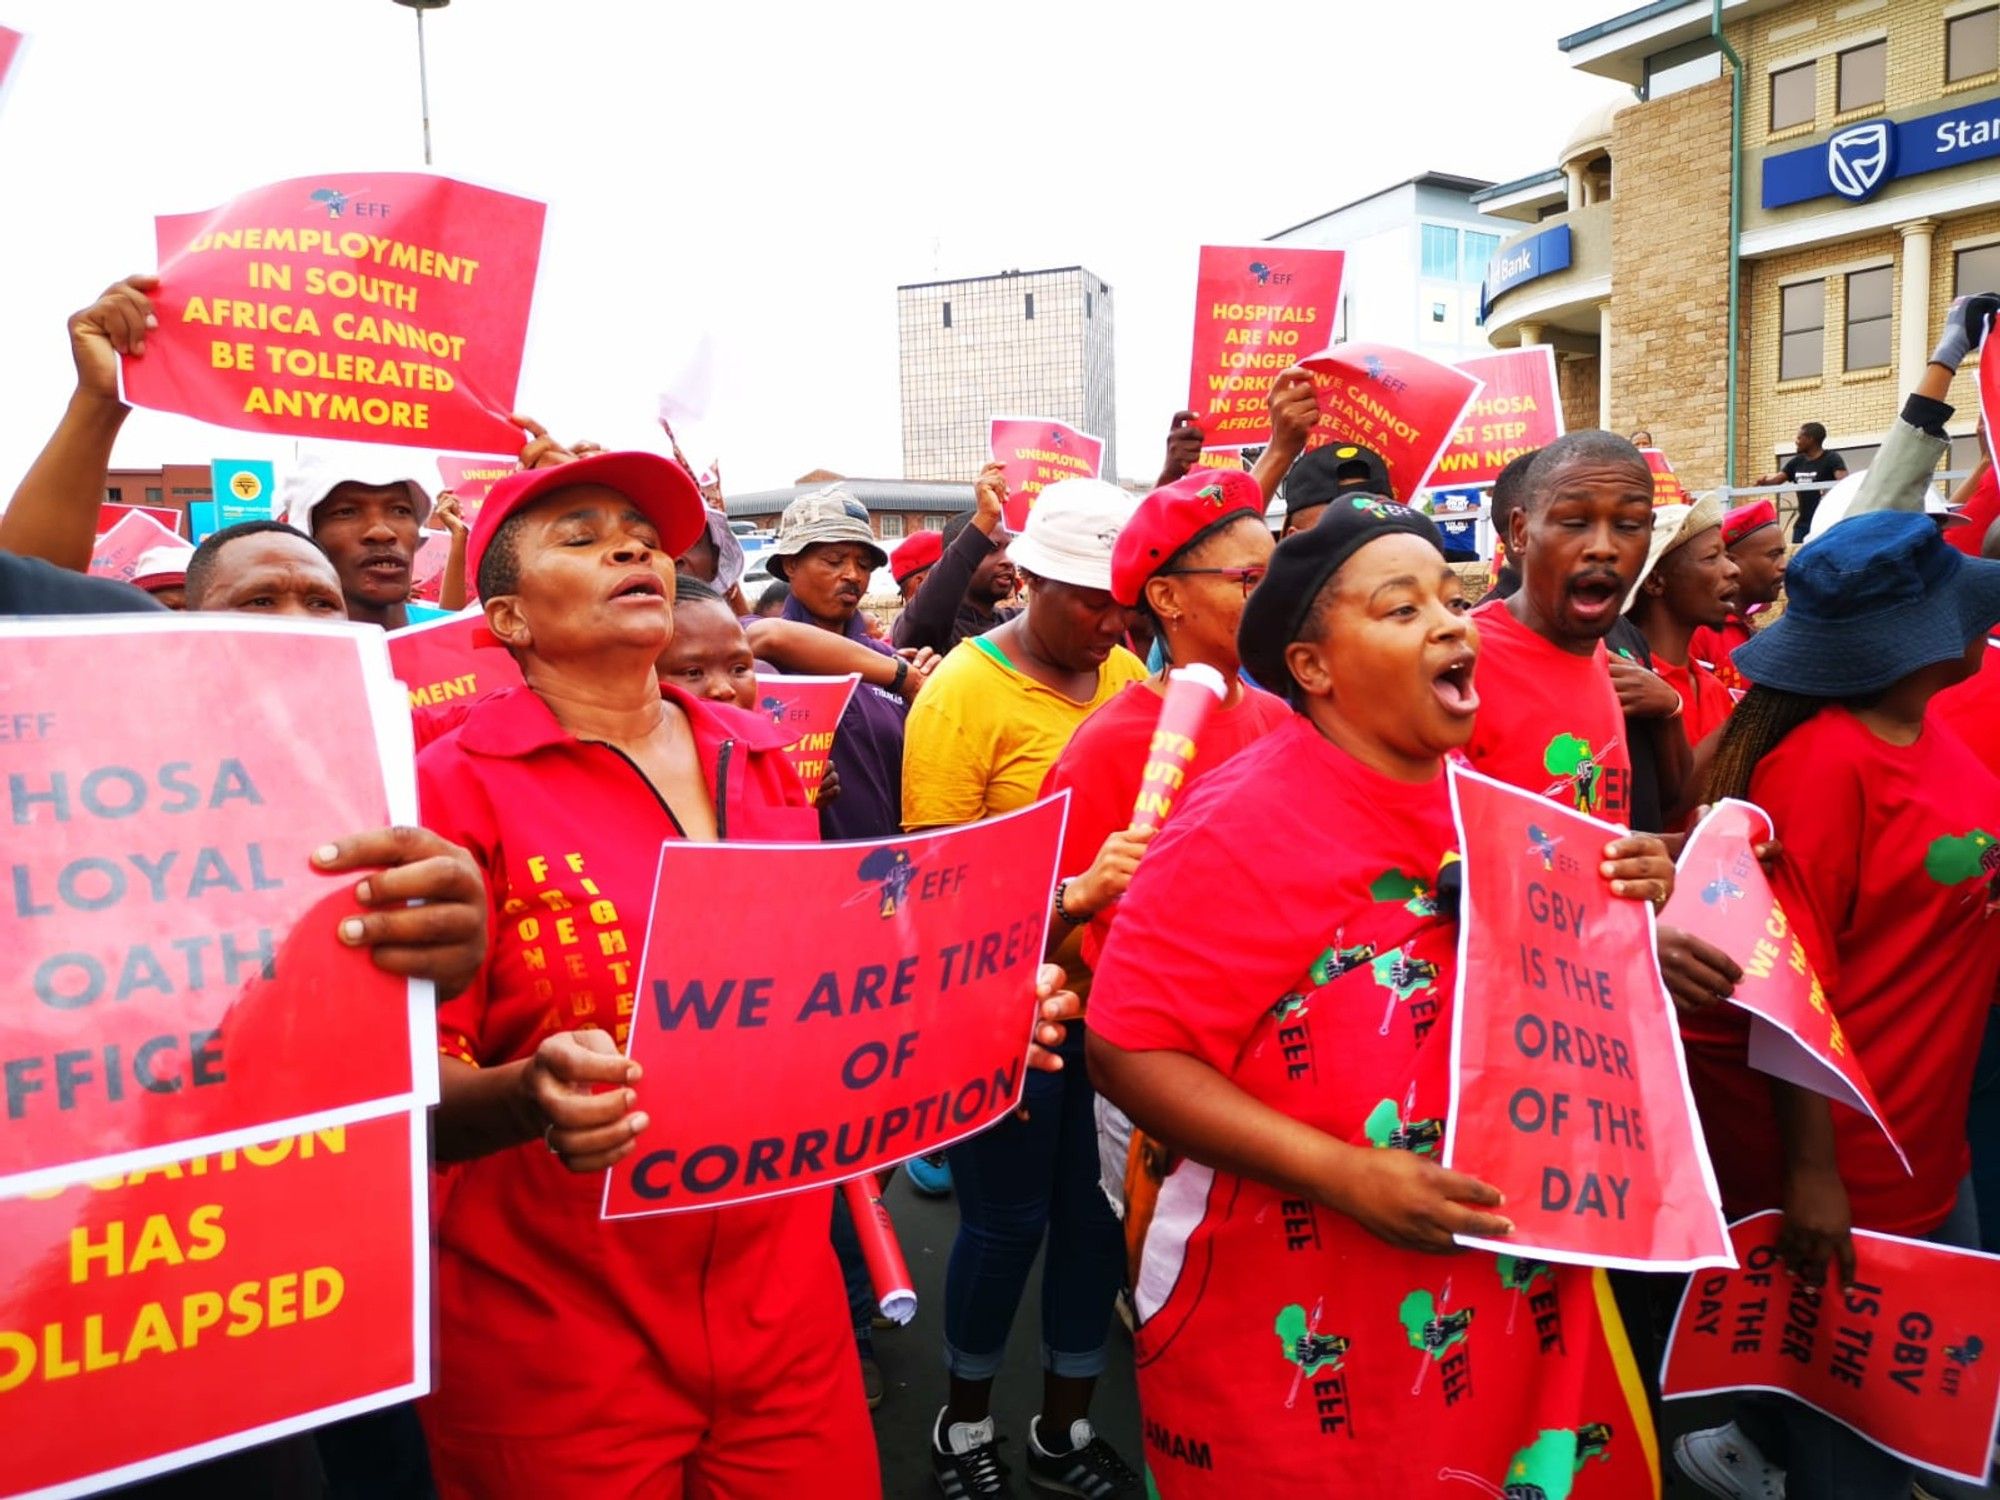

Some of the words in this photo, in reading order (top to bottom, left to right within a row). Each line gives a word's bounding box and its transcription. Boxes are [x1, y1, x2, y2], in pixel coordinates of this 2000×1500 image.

[355, 201, 391, 218] EFF
[189, 227, 479, 286] UNEMPLOYMENT
[1272, 273, 1293, 285] EFF
[1502, 248, 1532, 281] Bank
[248, 262, 290, 290] IN
[305, 267, 417, 313] SOUTH
[1212, 303, 1316, 323] HOSPITALS
[183, 297, 320, 337] AFRICA
[332, 313, 465, 362] CANNOT
[1224, 328, 1262, 345] ARE
[1267, 330, 1299, 346] NO
[211, 341, 254, 371] BE
[267, 346, 455, 394] TOLERATED
[1208, 375, 1276, 391] WORKI
[1220, 352, 1297, 369] LONGER
[1381, 375, 1408, 393] EFF
[244, 388, 429, 430] ANYMORE
[1209, 398, 1230, 414] IN
[1311, 371, 1344, 390] WE
[1347, 385, 1421, 444] CANNOT
[1329, 395, 1376, 432] HAVE
[1376, 432, 1389, 446] A
[1481, 421, 1527, 442] STEP
[1485, 446, 1541, 468] NO
[790, 709, 811, 722] EFF
[8, 757, 265, 826] HOSA
[12, 842, 284, 918] LOYAL
[918, 863, 970, 903] EFF
[1527, 881, 1586, 939] GBV
[1745, 938, 1781, 980] WE
[1765, 897, 1788, 939] CA
[34, 929, 277, 1010] OATH
[653, 976, 775, 1033] WE
[795, 955, 920, 1025] ARE
[938, 908, 1042, 993] TIRED
[1520, 947, 1547, 990] IS
[1555, 957, 1616, 1011] THE
[4, 1029, 227, 1120] FFICE
[840, 1030, 920, 1091] OF
[1513, 1013, 1636, 1081] ORDER
[629, 1057, 1022, 1200] CORRUPTION
[1508, 1087, 1569, 1136] OF
[1586, 1098, 1647, 1151] THE
[1540, 1165, 1633, 1222] DAY
[70, 1204, 227, 1284] HAS
[1744, 1244, 1782, 1289] OF
[1693, 1274, 1729, 1338] DAY
[1731, 1299, 1773, 1356] THE
[1843, 1281, 1883, 1318] IS
[0, 1266, 345, 1393] OLLAPSED
[1887, 1311, 1933, 1395] GBV
[1829, 1326, 1877, 1391] THE
